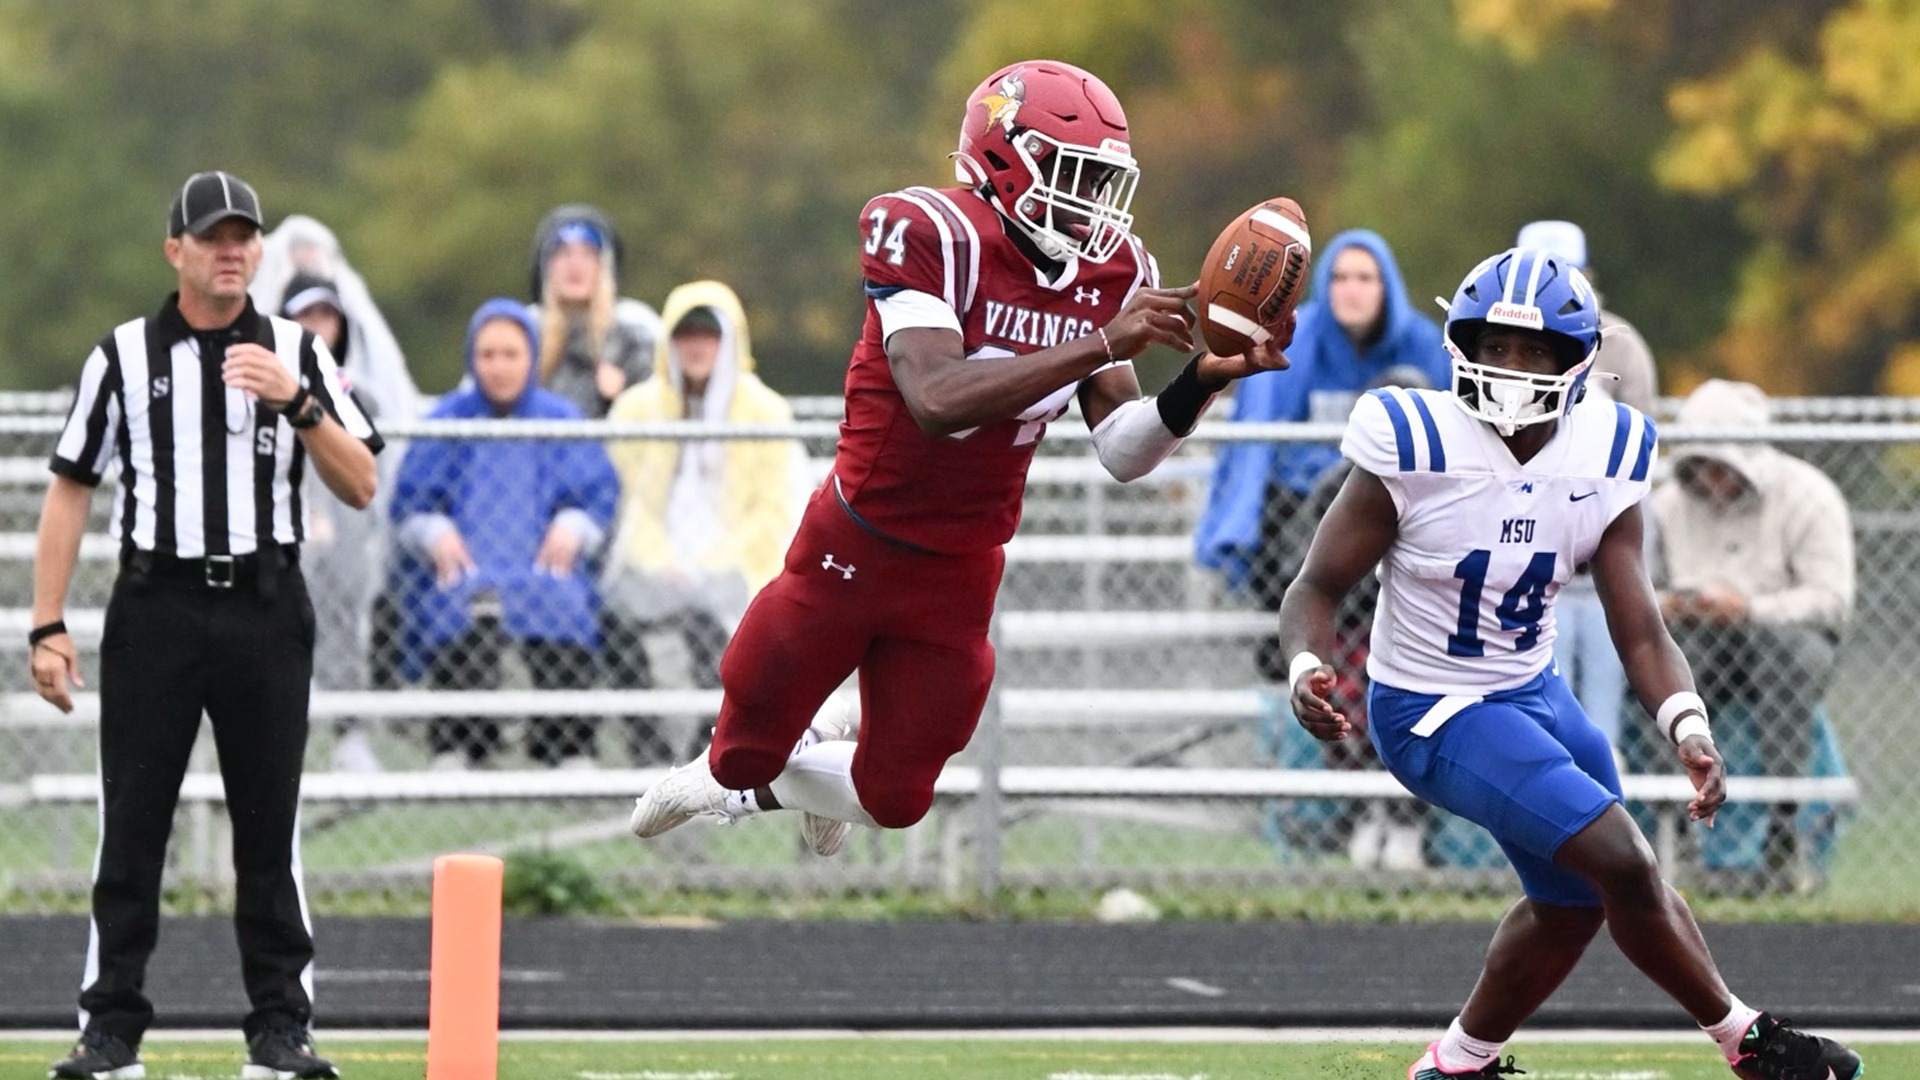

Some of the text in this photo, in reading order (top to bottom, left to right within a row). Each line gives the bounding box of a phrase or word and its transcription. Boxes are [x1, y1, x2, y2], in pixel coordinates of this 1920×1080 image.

[865, 207, 910, 266] 34
[1224, 244, 1241, 271] NCAA
[1249, 249, 1279, 296] Wilson
[983, 300, 1094, 347] VIKINGS
[1493, 307, 1538, 322] Riddell
[153, 376, 170, 398] S
[257, 426, 275, 455] S
[1500, 519, 1536, 543] MSU
[1447, 549, 1557, 657] 14
